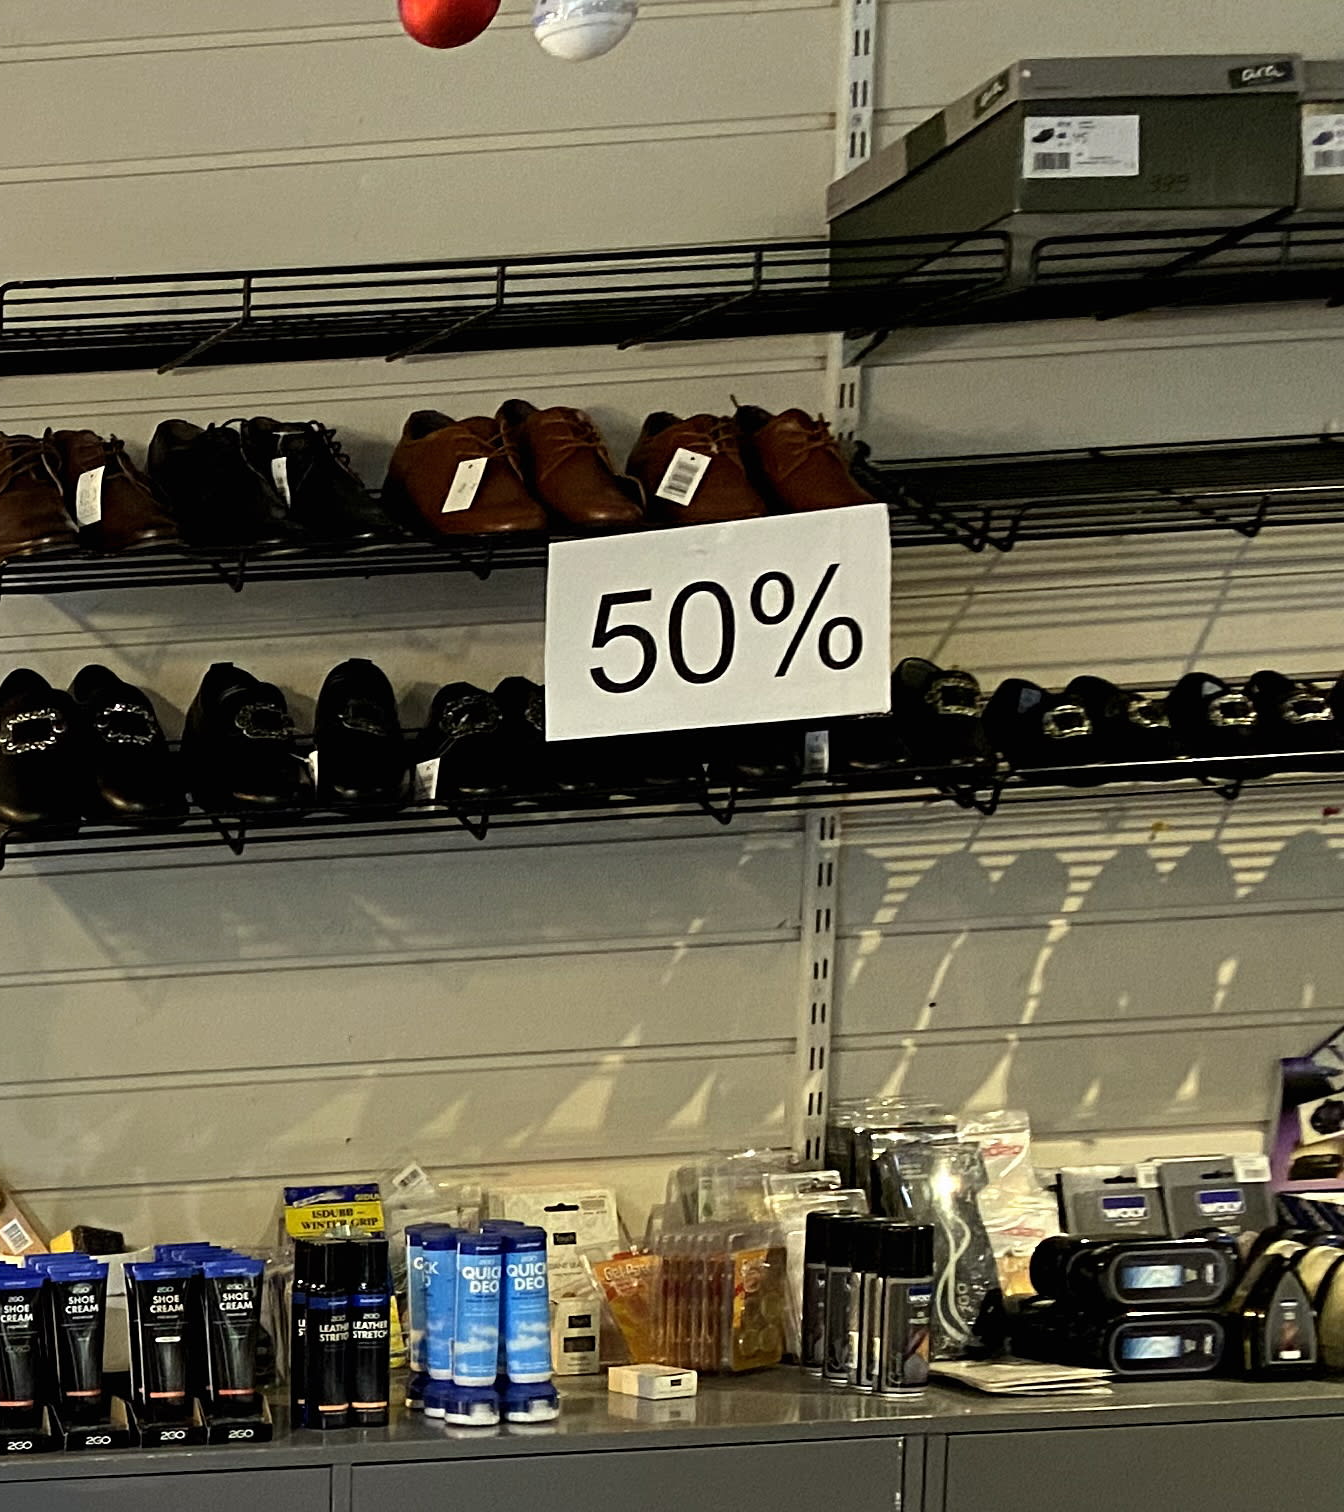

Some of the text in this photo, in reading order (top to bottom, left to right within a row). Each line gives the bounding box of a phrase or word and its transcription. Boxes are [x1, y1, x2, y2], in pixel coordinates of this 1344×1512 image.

[589, 563, 864, 694] 50%
[462, 1266, 501, 1280] QUIC
[506, 1262, 546, 1277] QUIC
[469, 1280, 500, 1293] DEO
[514, 1276, 545, 1291] DEO
[68, 1295, 95, 1304] SHOE
[152, 1295, 180, 1304] SHOE
[222, 1292, 249, 1301] SHOE
[3, 1304, 30, 1314] SHOE
[65, 1304, 99, 1314] CREAM
[149, 1304, 184, 1313] CREAM
[219, 1301, 254, 1311] CREAM
[0, 1314, 34, 1323] CREAM
[160, 1430, 186, 1440] 2GO
[228, 1428, 254, 1439] 2GO
[85, 1435, 112, 1445] 2GO
[7, 1440, 33, 1451] 2GO
